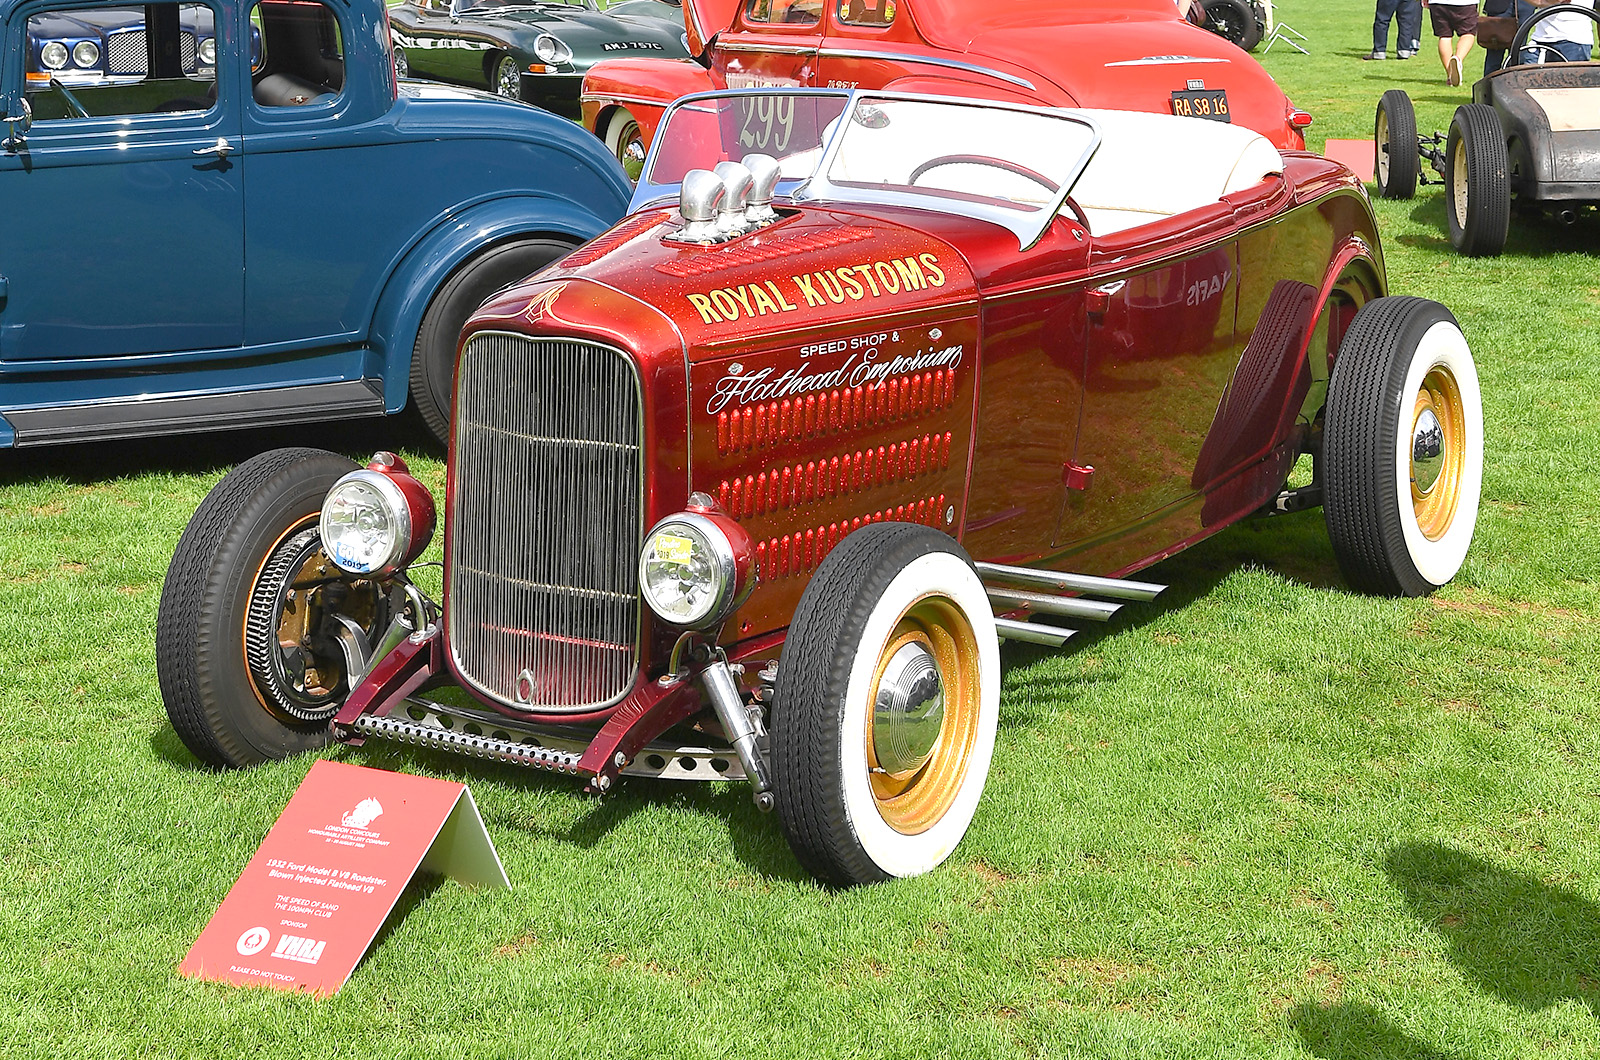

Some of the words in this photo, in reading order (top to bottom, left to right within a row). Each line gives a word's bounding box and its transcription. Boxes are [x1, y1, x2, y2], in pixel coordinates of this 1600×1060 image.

[604, 42, 628, 51] AMJ
[630, 42, 662, 50] 757C
[1174, 98, 1193, 116] RA
[1193, 97, 1211, 116] S8
[1212, 97, 1228, 115] 16
[740, 81, 795, 152] 299
[686, 279, 798, 325] ROYAL
[792, 252, 946, 308] KUSTOMS
[800, 340, 847, 358] SPEED
[850, 333, 887, 351] SHOP
[891, 331, 900, 342] &
[706, 353, 857, 415] Flathead
[849, 345, 963, 391] Emporium
[342, 558, 362, 569] 2019
[308, 829, 341, 839] HONOURABLE
[365, 838, 390, 847] COMPANY
[325, 825, 349, 834] LONDON
[349, 829, 380, 839] CONCOURS
[266, 858, 287, 868] 1932
[286, 862, 306, 872] Ford
[305, 865, 332, 877] Model
[331, 869, 339, 877] B
[338, 871, 351, 879] V8
[350, 873, 387, 887] Roadster,
[268, 869, 294, 880] Blown
[294, 873, 327, 886] Injected
[326, 879, 363, 892] Flathead
[362, 885, 375, 894] V8
[274, 902, 287, 911] THE
[287, 904, 314, 915] 100MPH
[313, 910, 333, 918] CLUB
[276, 894, 290, 903] THE
[290, 897, 310, 906] SPEED
[320, 903, 340, 911] SAND
[279, 919, 308, 929] SPONSOR
[274, 934, 327, 960] VHRA
[229, 965, 251, 975] PLEASE
[250, 968, 260, 976] DO
[260, 971, 274, 979] NOT
[273, 974, 296, 982] TOUCH
